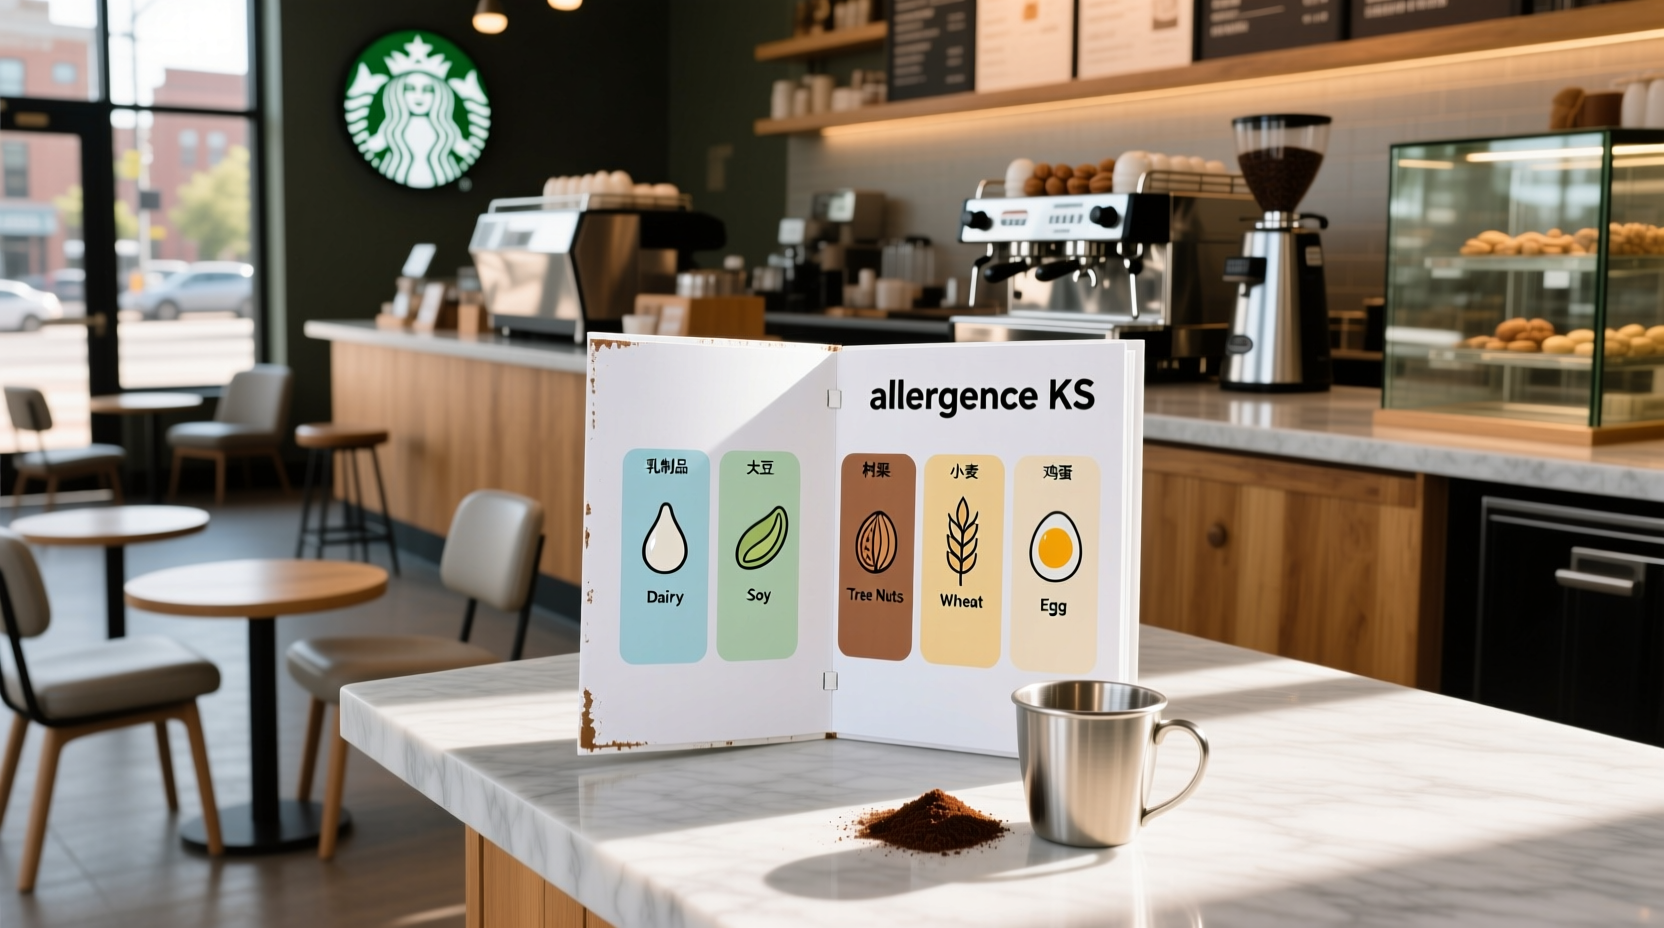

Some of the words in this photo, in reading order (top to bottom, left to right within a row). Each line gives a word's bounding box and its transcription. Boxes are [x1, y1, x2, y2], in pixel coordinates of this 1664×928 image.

[869, 379, 1039, 418] allergence
[1049, 378, 1095, 411] KS
[645, 458, 689, 476] 乳制品
[747, 459, 774, 475] 大豆
[950, 463, 979, 480] 小麦
[1043, 464, 1074, 481] 鸡蛋
[647, 590, 685, 607] Dairy
[747, 588, 772, 605] Soy
[846, 587, 873, 602] Tree
[876, 588, 904, 604] Nuts
[940, 593, 984, 609] Wheat
[1040, 598, 1068, 617] Egg
